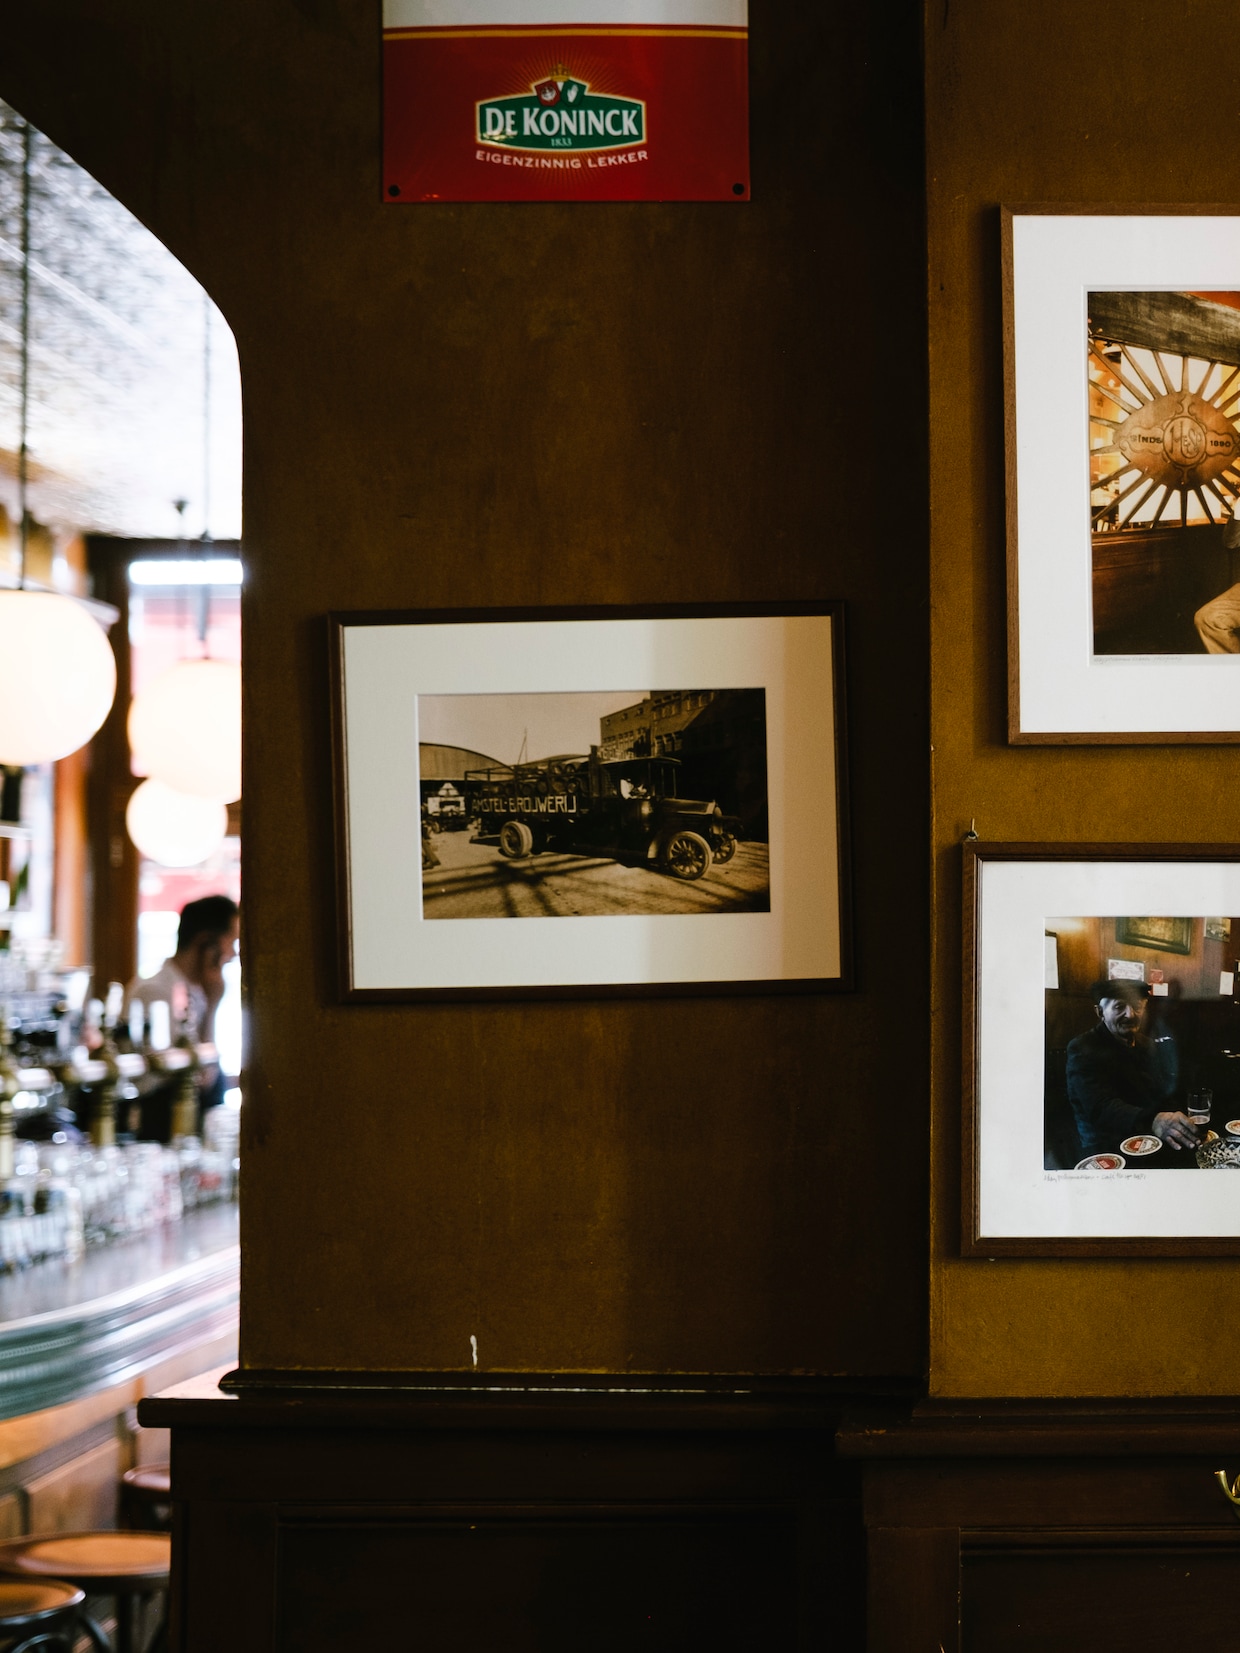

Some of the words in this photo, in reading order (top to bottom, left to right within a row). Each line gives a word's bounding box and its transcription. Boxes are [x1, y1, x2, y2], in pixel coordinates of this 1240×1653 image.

[485, 107, 518, 136] DE
[522, 107, 639, 137] KONINCK
[475, 150, 582, 169] EIGENZINNIG
[587, 150, 648, 169] LEKKER
[1210, 440, 1231, 448] 1890
